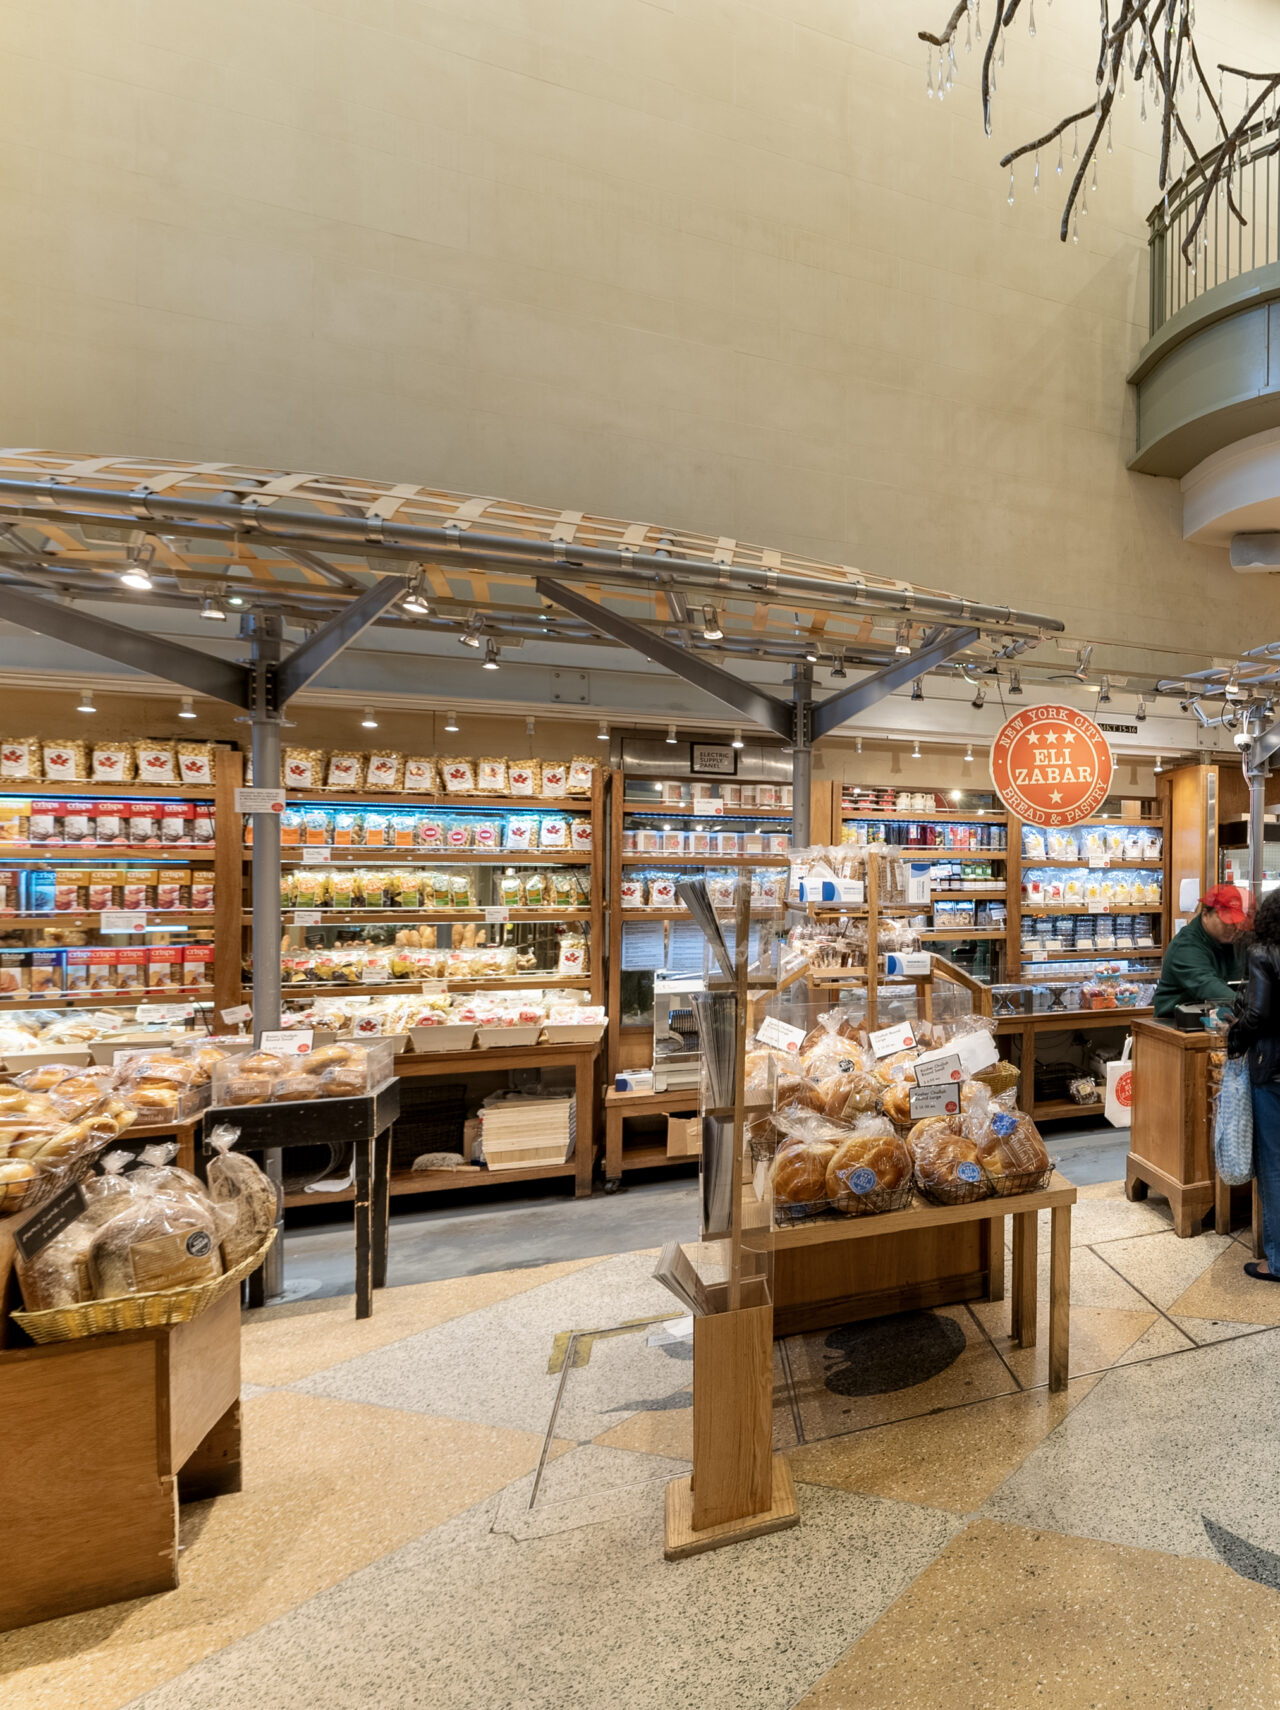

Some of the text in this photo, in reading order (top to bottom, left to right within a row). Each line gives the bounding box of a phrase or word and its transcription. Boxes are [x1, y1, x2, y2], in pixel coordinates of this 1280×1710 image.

[999, 708, 1103, 748] NEW YORK CITY
[1033, 748, 1072, 765] ELI
[1015, 766, 1093, 785] ZABAR
[1002, 778, 1107, 825] BREAD & PASTRY
